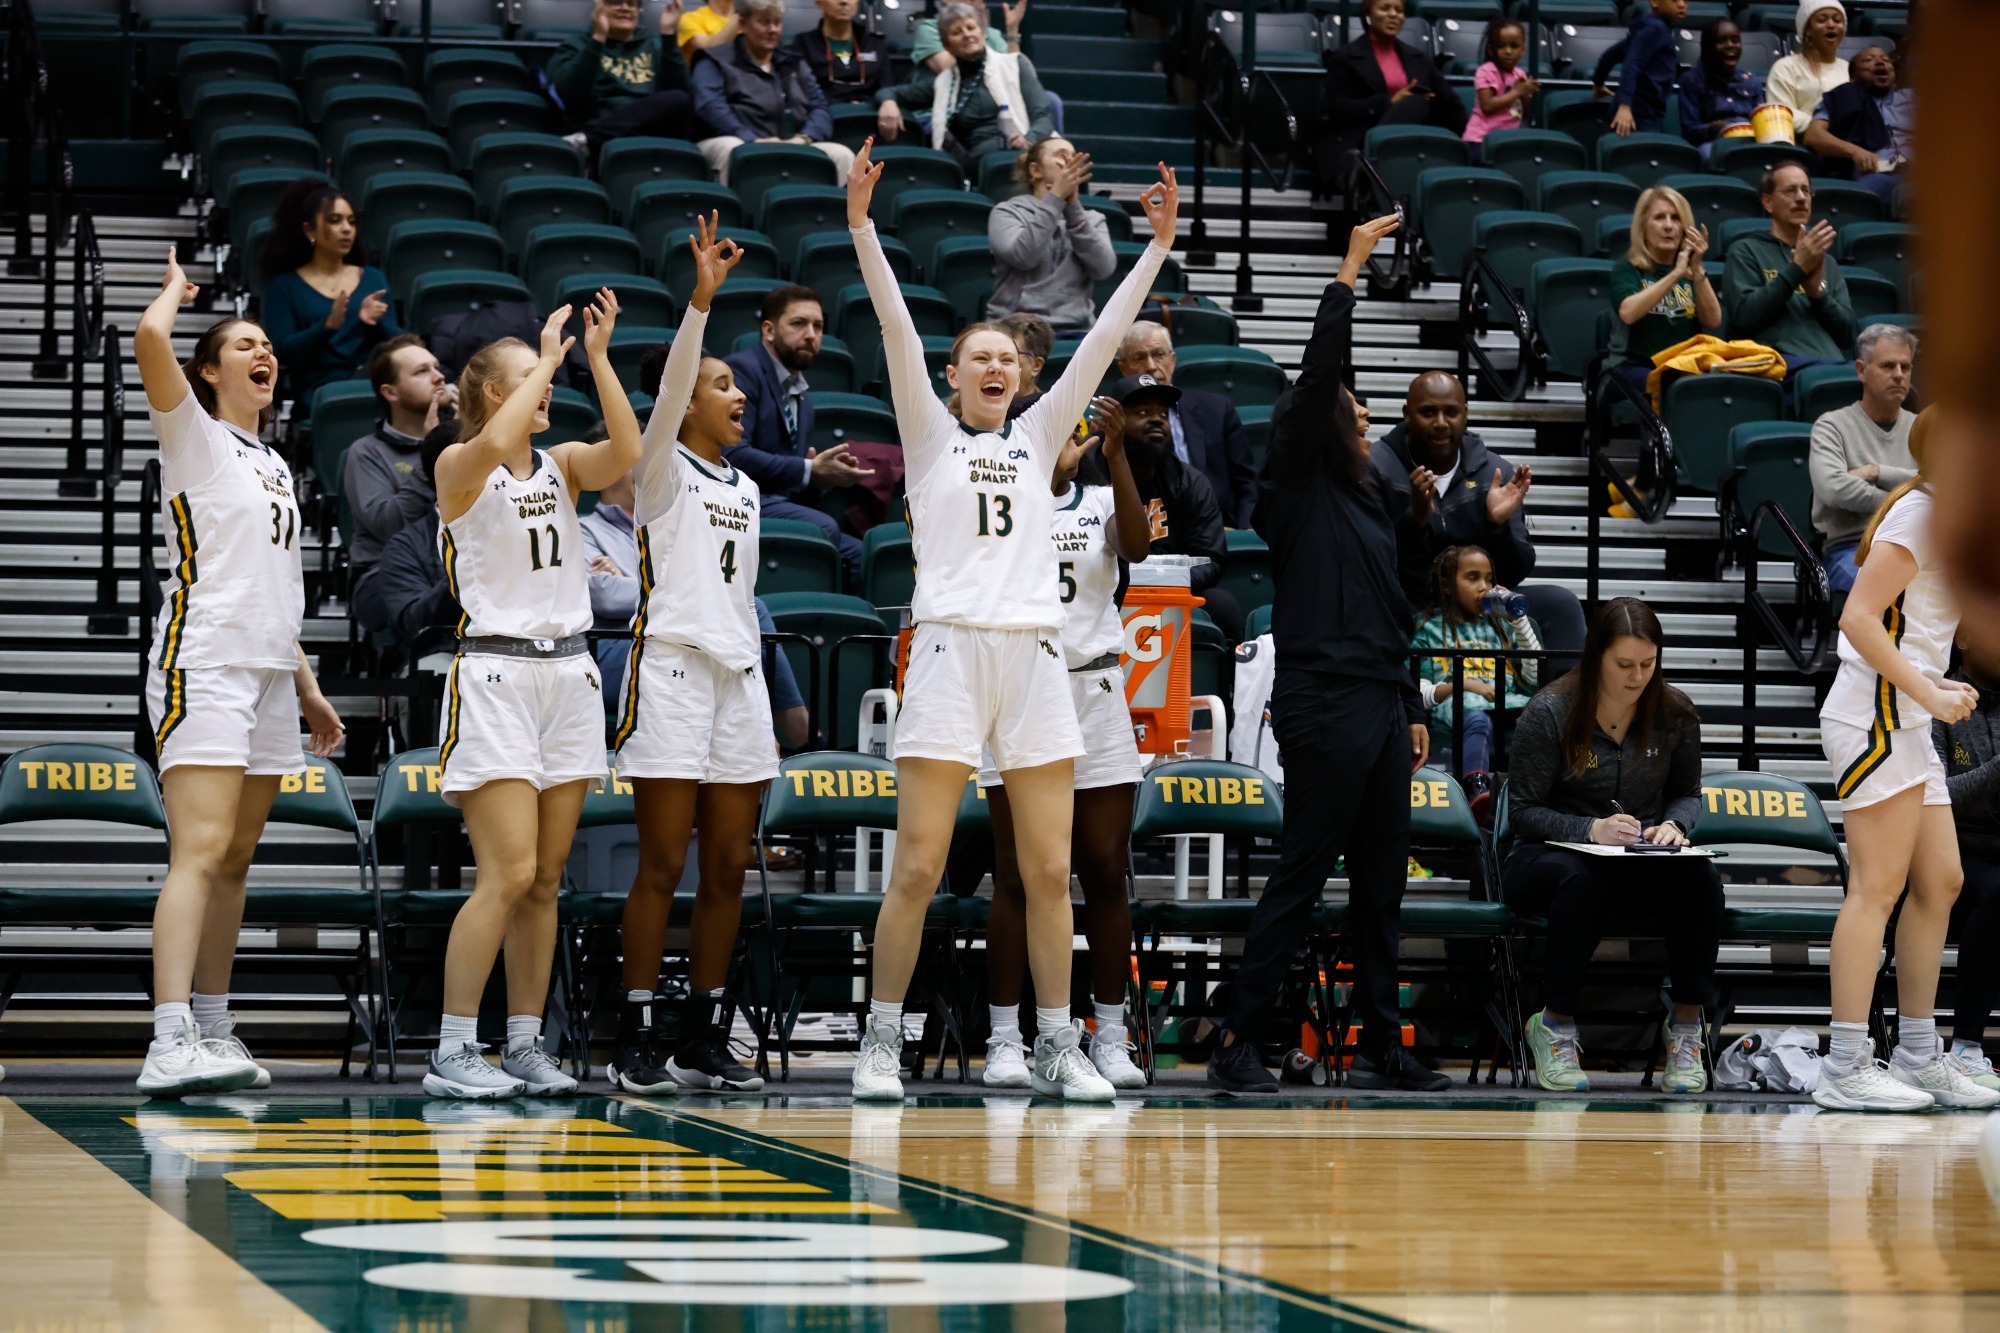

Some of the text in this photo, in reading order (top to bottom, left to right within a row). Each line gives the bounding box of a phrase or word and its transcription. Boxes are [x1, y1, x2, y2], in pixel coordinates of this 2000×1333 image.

[968, 458, 1018, 473] WILLIAM
[1008, 448, 1029, 460] CAA
[510, 491, 557, 504] WILLIAM
[703, 501, 749, 521] WILLIAM
[270, 501, 294, 551] 31
[975, 492, 1013, 537] 13
[1078, 516, 1100, 527] CAA
[527, 523, 562, 572] 12
[719, 539, 737, 584] 4
[1123, 614, 1162, 663] G
[19, 762, 136, 790] TRIBE
[785, 769, 898, 797] TRIBE
[1154, 776, 1265, 805] TRIBE
[1701, 786, 1807, 818] TRIBE
